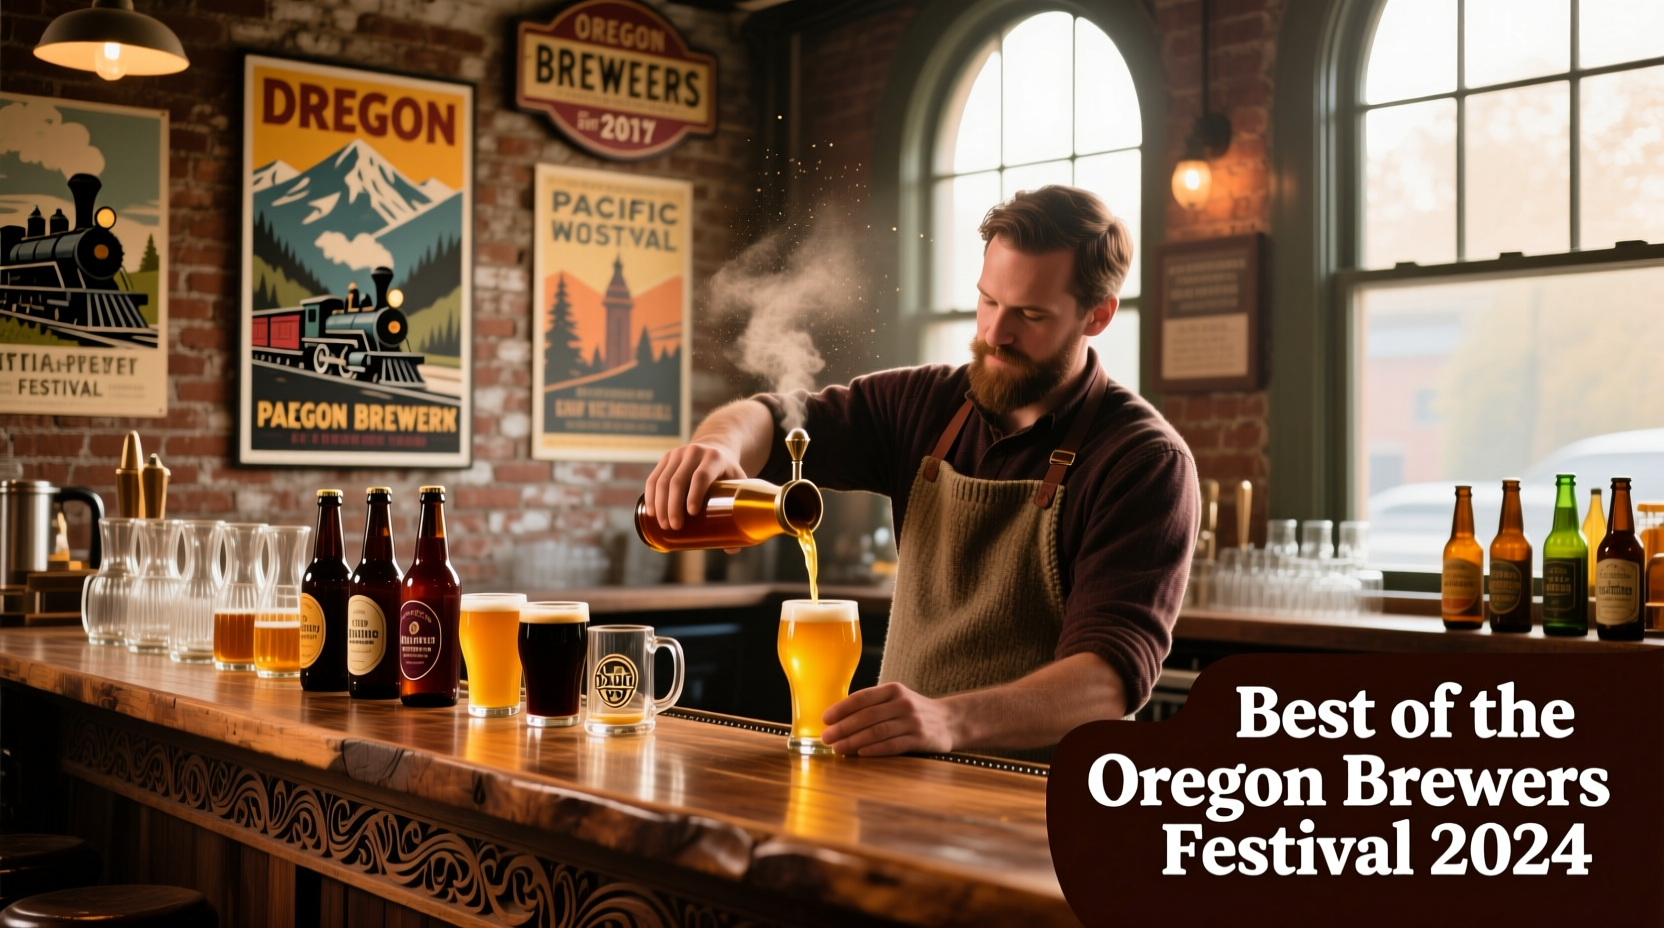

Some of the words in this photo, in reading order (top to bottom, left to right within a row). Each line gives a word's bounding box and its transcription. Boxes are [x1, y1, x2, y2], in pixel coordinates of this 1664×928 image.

[574, 13, 666, 52] OREGON
[536, 44, 700, 107] BREWEERS
[262, 77, 457, 146] DREGON
[552, 190, 678, 225] PACIFIC
[552, 220, 677, 252] WOSTVAL
[18, 378, 103, 397] FESTIVAL
